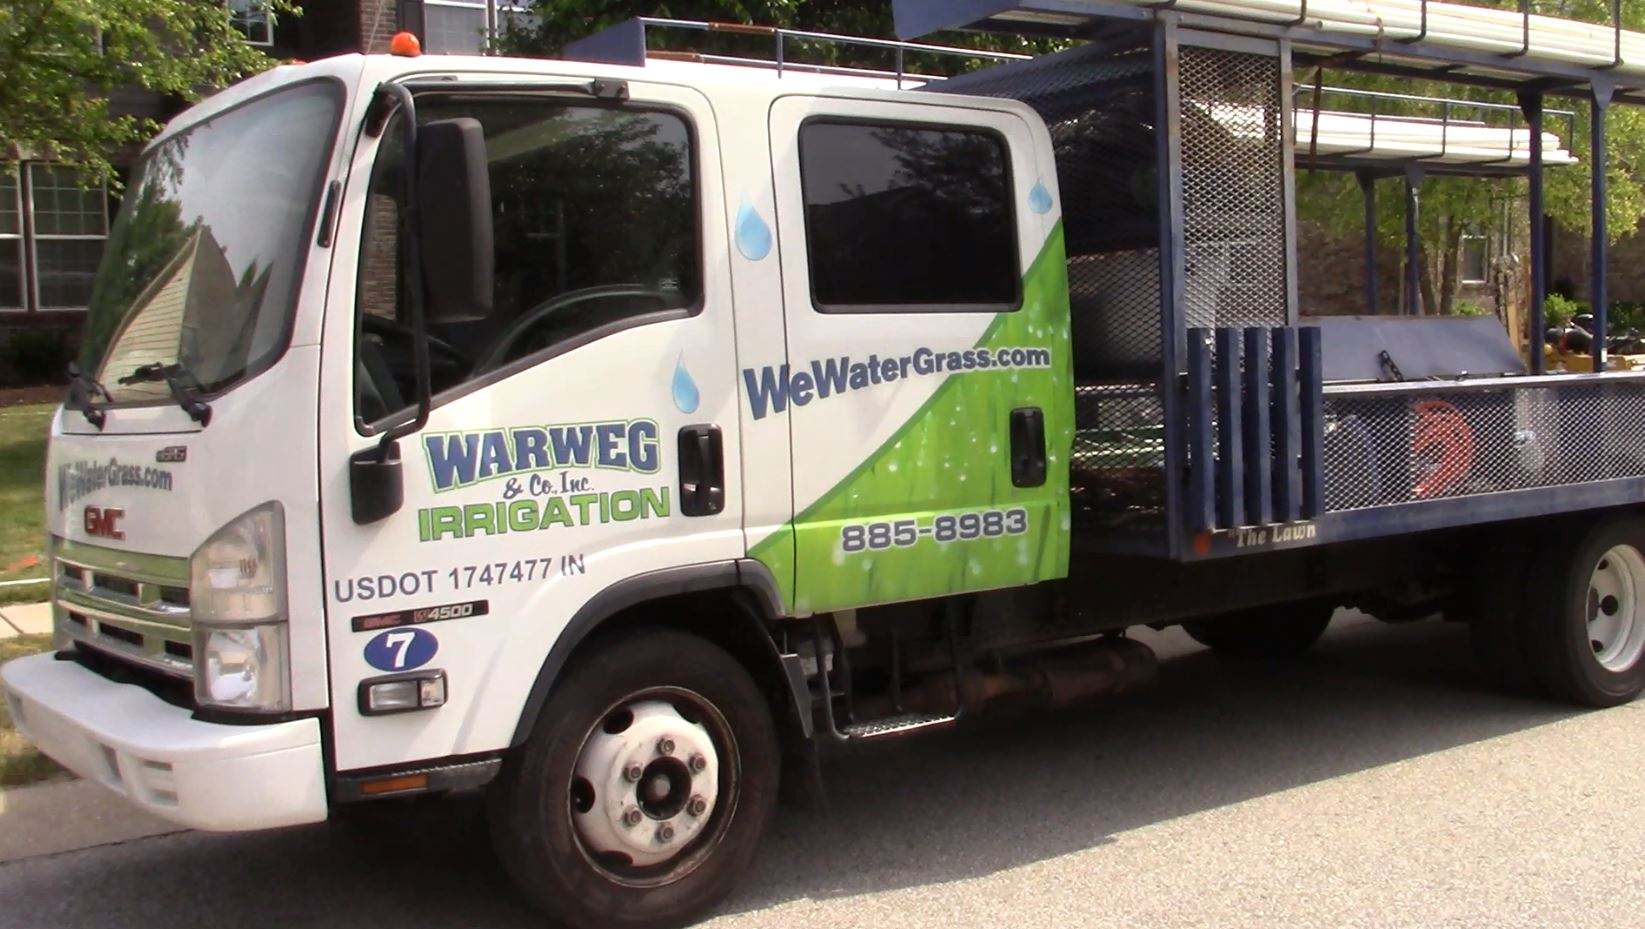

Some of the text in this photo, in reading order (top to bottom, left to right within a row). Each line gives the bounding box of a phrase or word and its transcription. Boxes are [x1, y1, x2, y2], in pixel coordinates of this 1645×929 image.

[743, 347, 1051, 421] WeWaterGrass.com
[422, 419, 662, 494] WARWEG
[503, 477, 524, 499] &
[84, 505, 126, 540] GMC
[417, 486, 670, 542] IRRIGATION
[842, 508, 1028, 552] 885-8983
[1271, 523, 1317, 543] Lawn
[334, 553, 586, 603] USDOT 1747477 IN
[385, 631, 416, 668] 7
